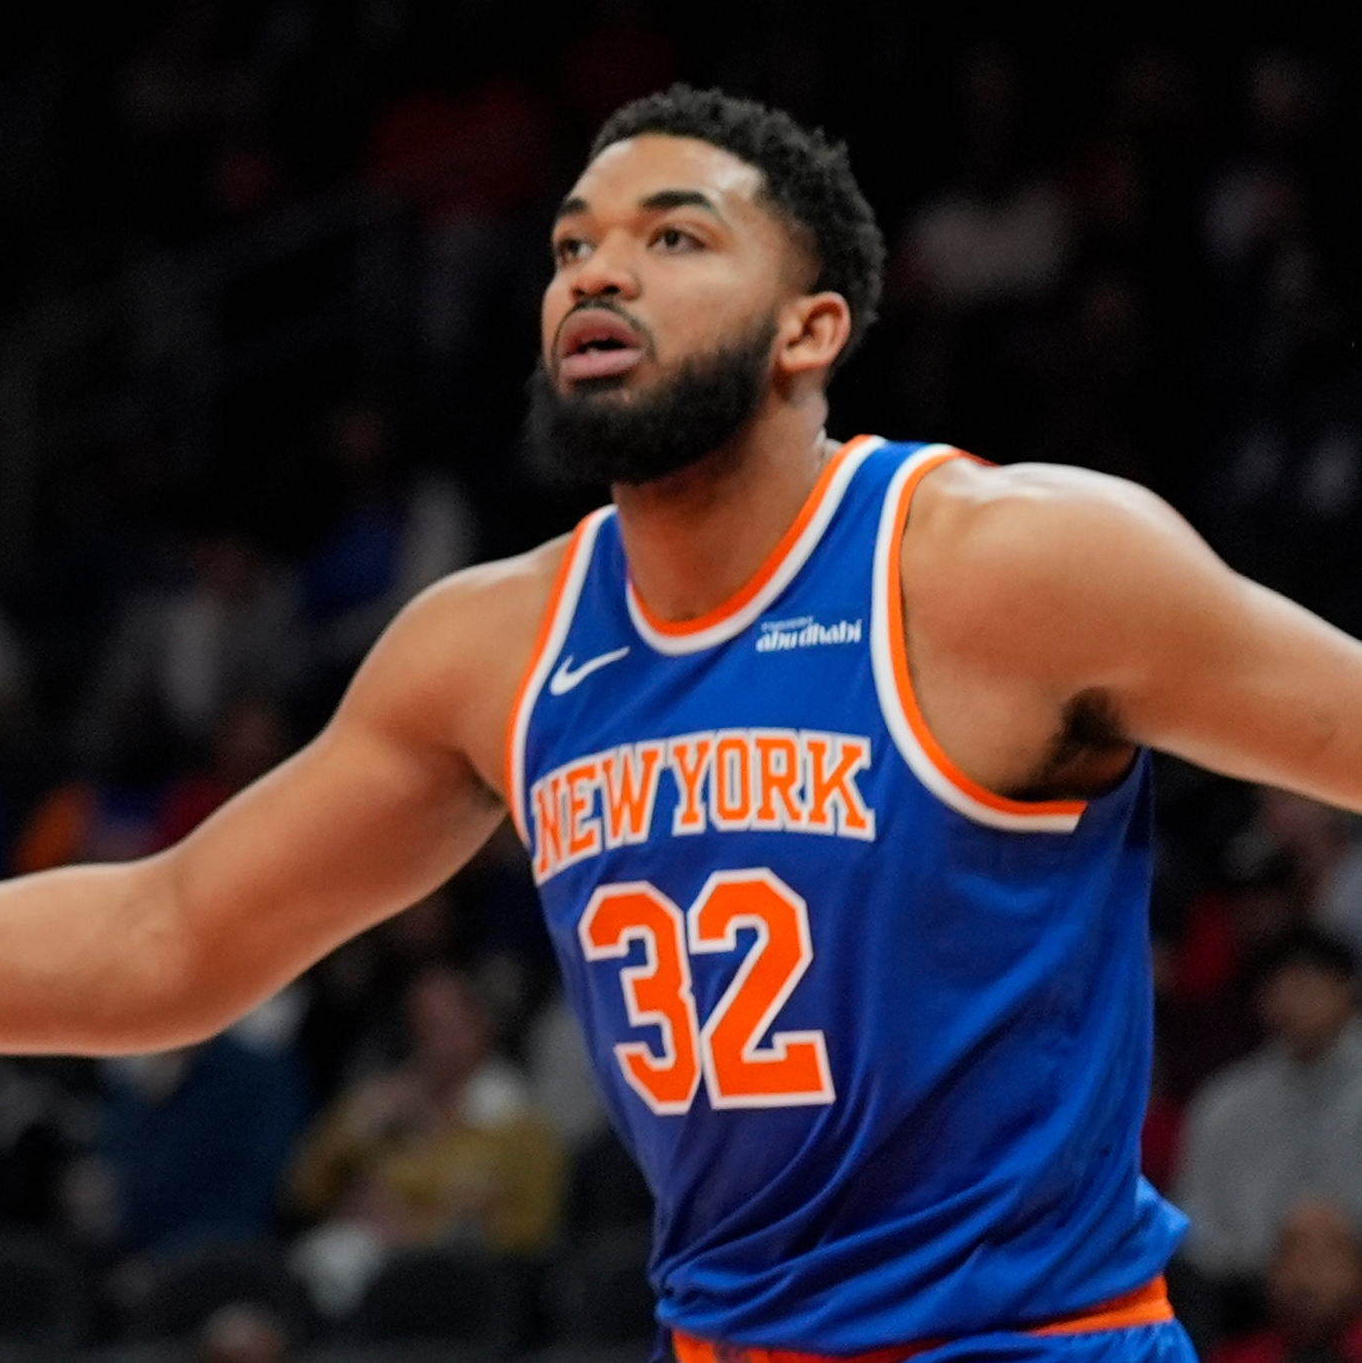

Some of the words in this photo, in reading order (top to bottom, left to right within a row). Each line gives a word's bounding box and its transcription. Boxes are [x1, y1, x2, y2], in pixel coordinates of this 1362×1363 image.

[531, 738, 666, 886] NEW
[667, 727, 875, 842] YORK
[579, 868, 836, 1115] 32
